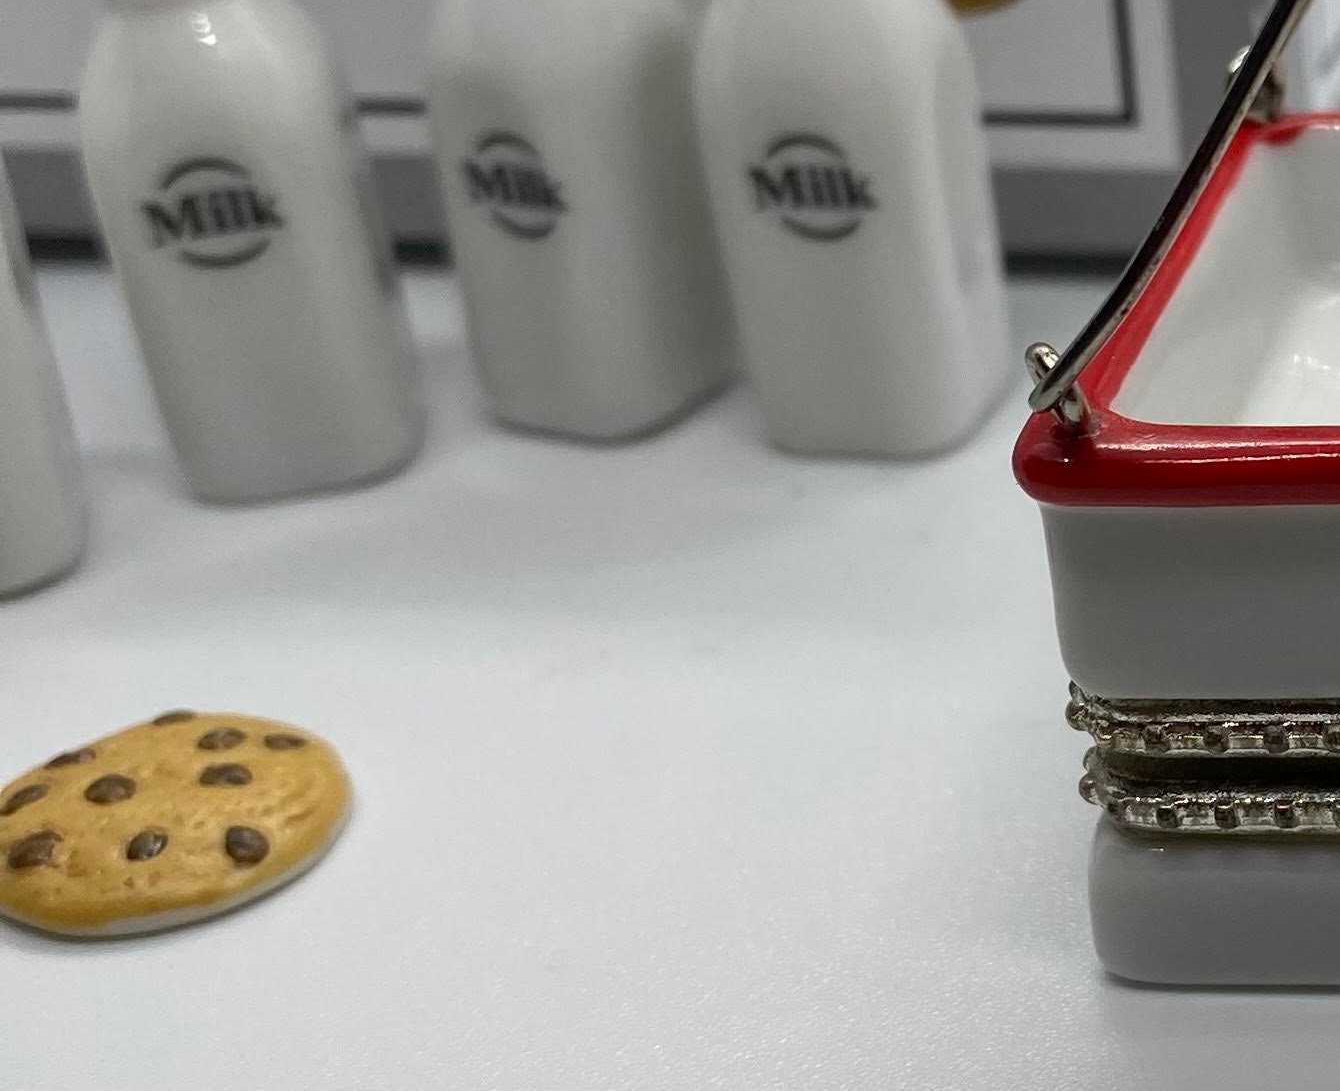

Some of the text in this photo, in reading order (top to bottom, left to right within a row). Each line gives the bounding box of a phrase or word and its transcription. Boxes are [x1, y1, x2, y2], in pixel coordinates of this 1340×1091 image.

[462, 154, 879, 216] Milk Milk
[142, 185, 286, 248] Milk
